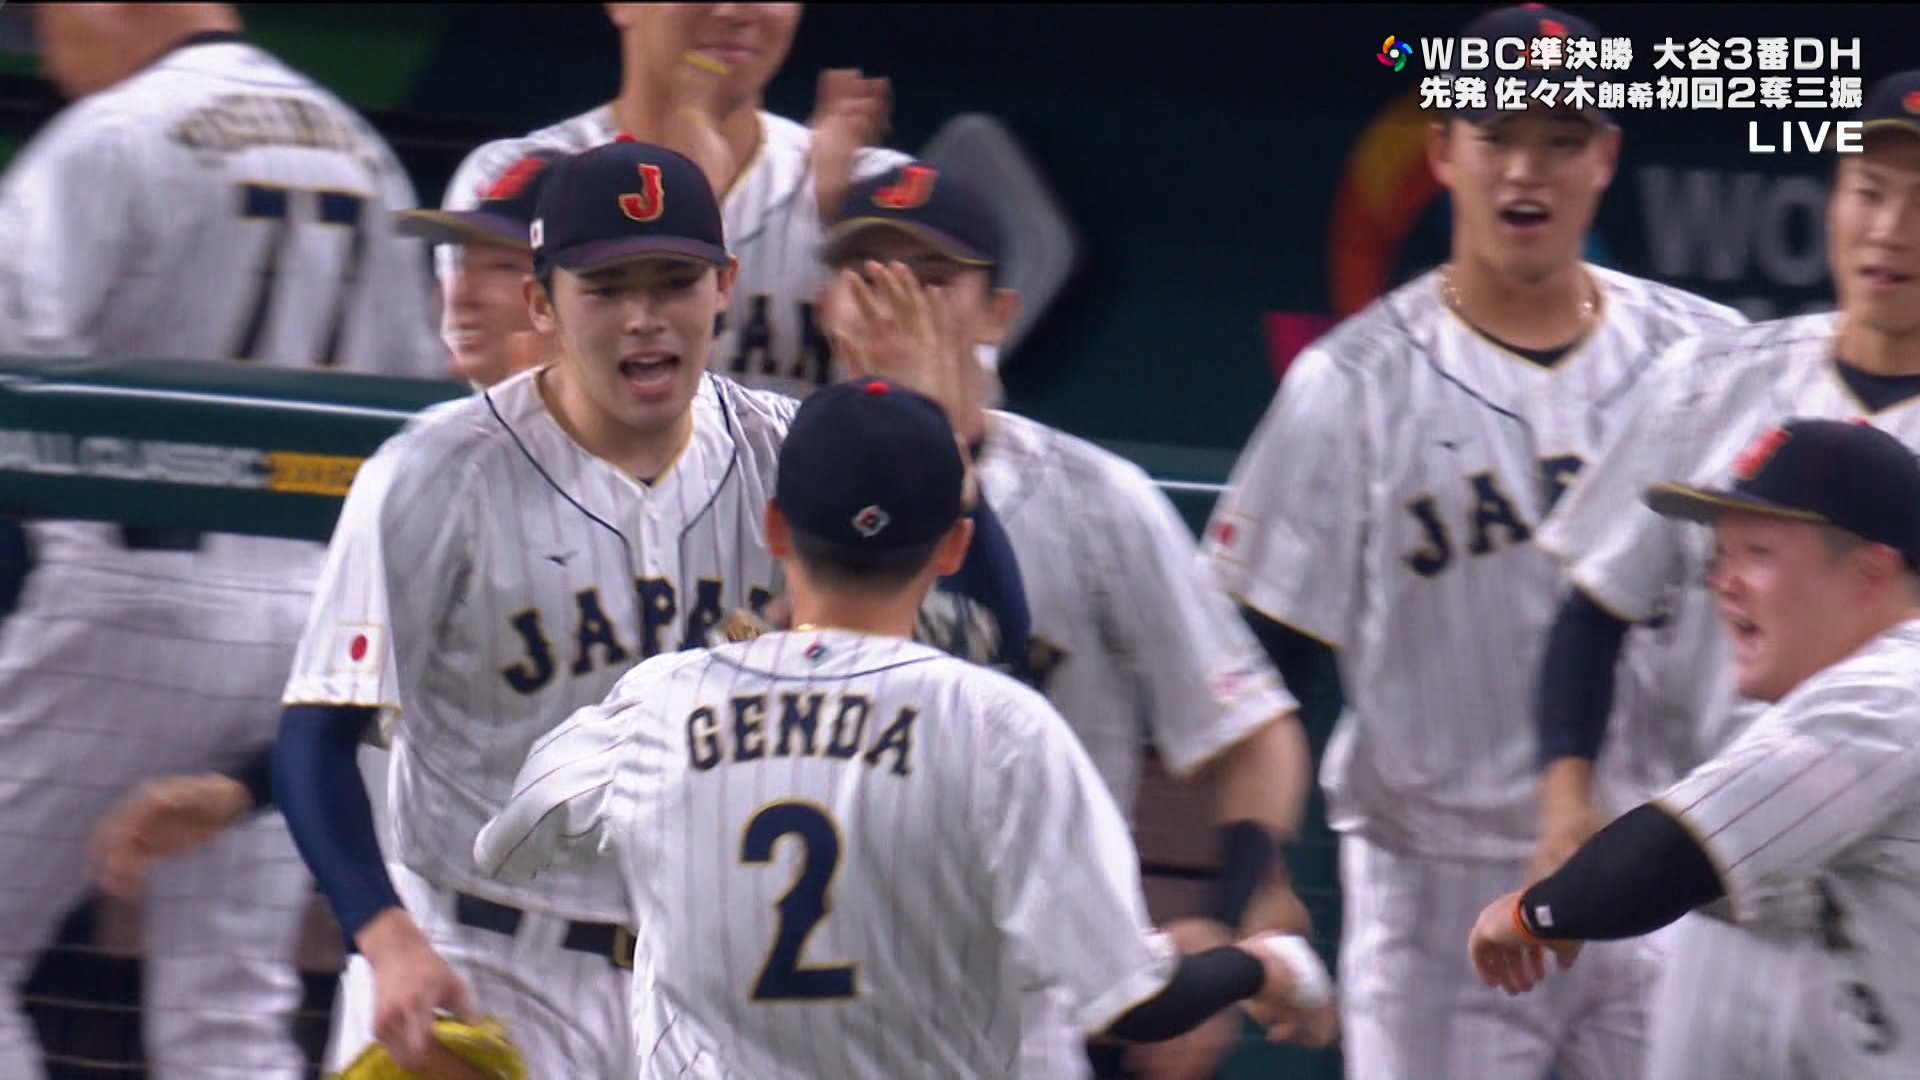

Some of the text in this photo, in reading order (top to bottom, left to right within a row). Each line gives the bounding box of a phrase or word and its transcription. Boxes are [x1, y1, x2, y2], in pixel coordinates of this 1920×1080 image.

[618, 162, 664, 222] J
[233, 182, 367, 367] 77
[500, 574, 771, 696] JAPA
[685, 691, 920, 777] GENDA
[740, 799, 863, 1004] 2
